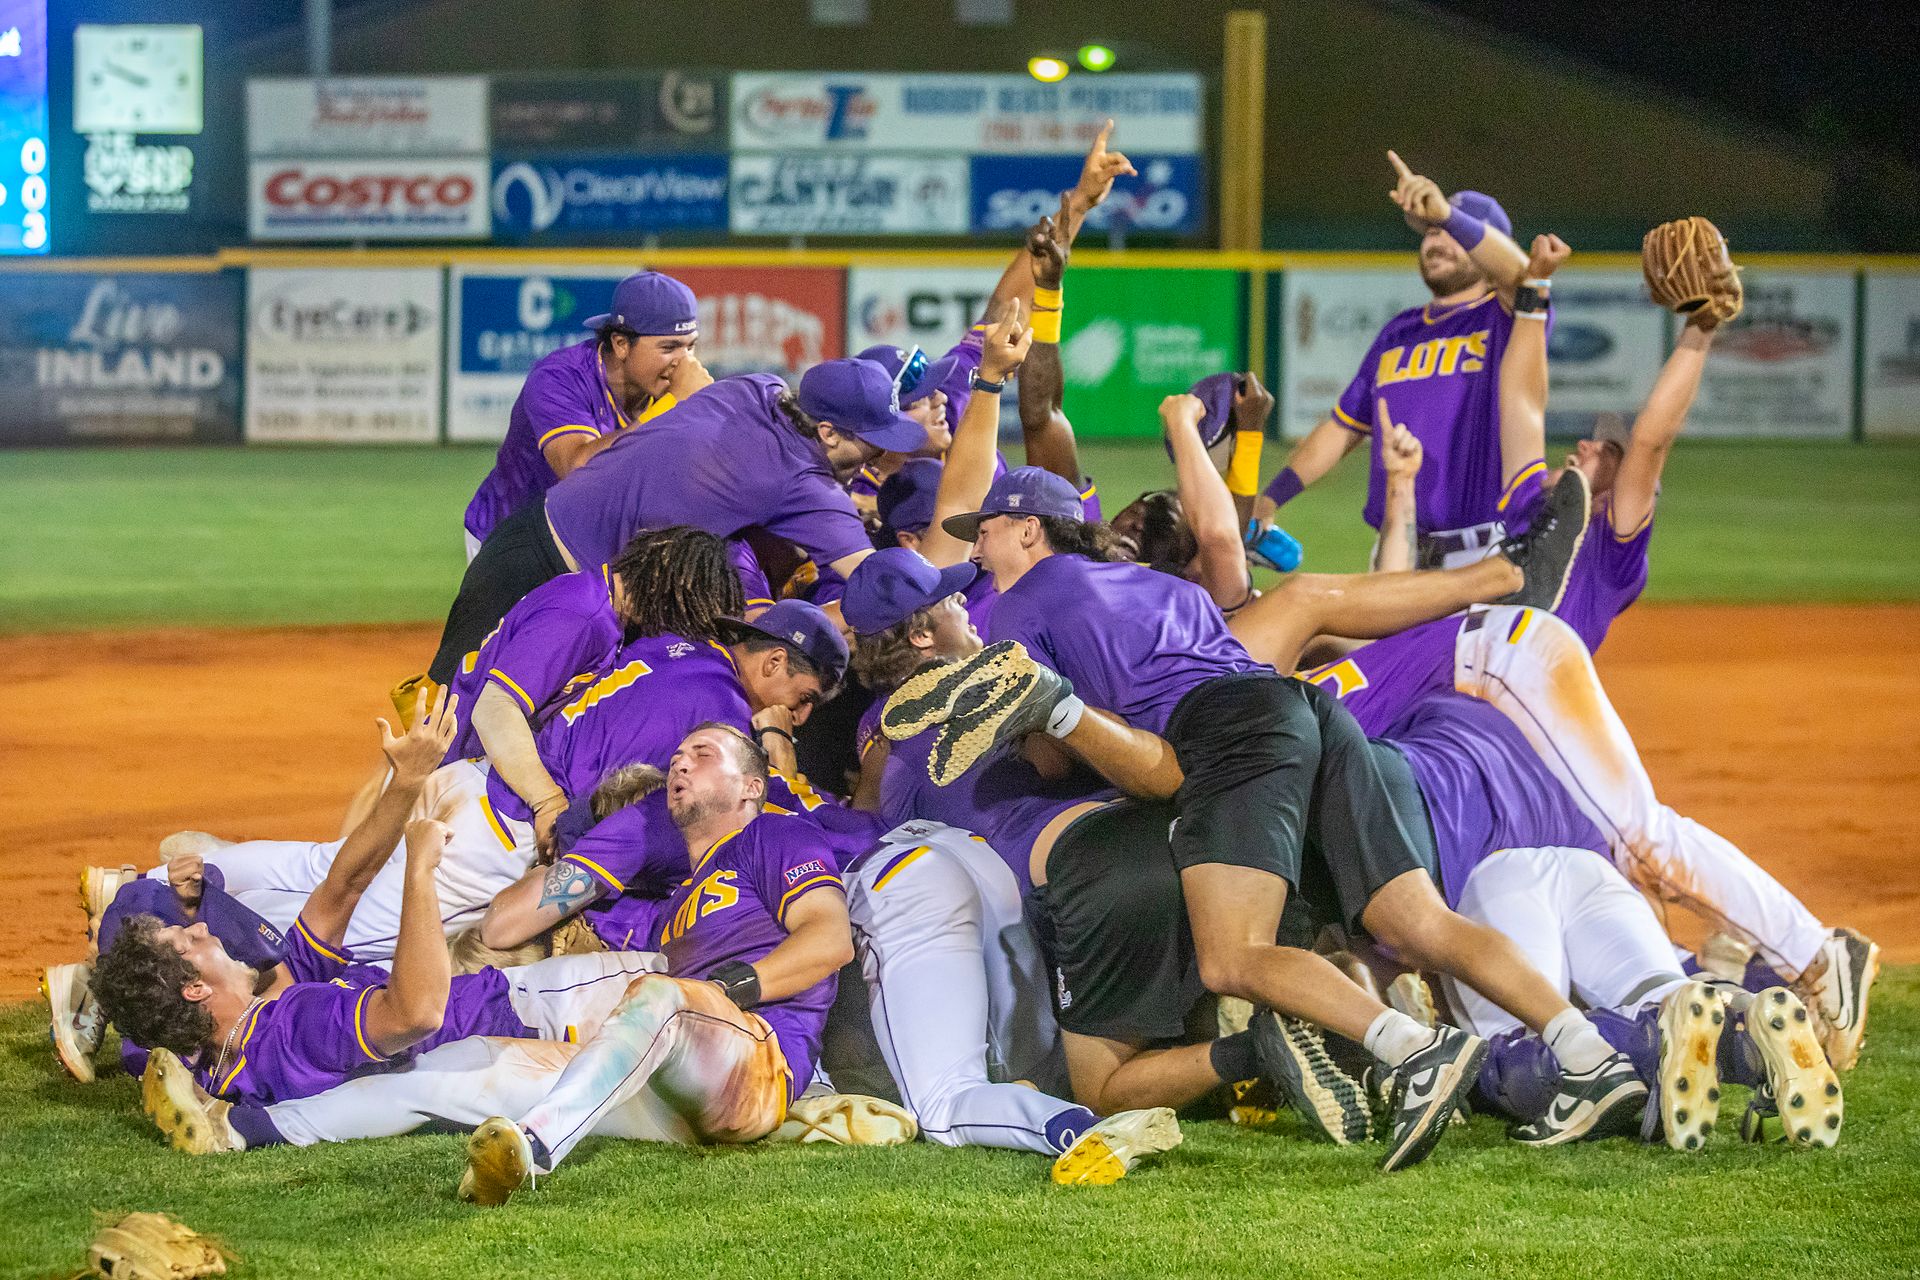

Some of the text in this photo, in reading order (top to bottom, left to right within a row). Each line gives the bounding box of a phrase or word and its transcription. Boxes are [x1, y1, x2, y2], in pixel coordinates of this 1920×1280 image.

[21, 137, 46, 174] 0
[21, 175, 47, 211] 0
[563, 166, 729, 205] ClearView
[22, 211, 47, 249] 3
[70, 278, 181, 347] Live
[907, 291, 990, 331] CT
[36, 348, 225, 388] INLAND
[785, 860, 825, 884] NAIA
[257, 922, 282, 946] LSUS
